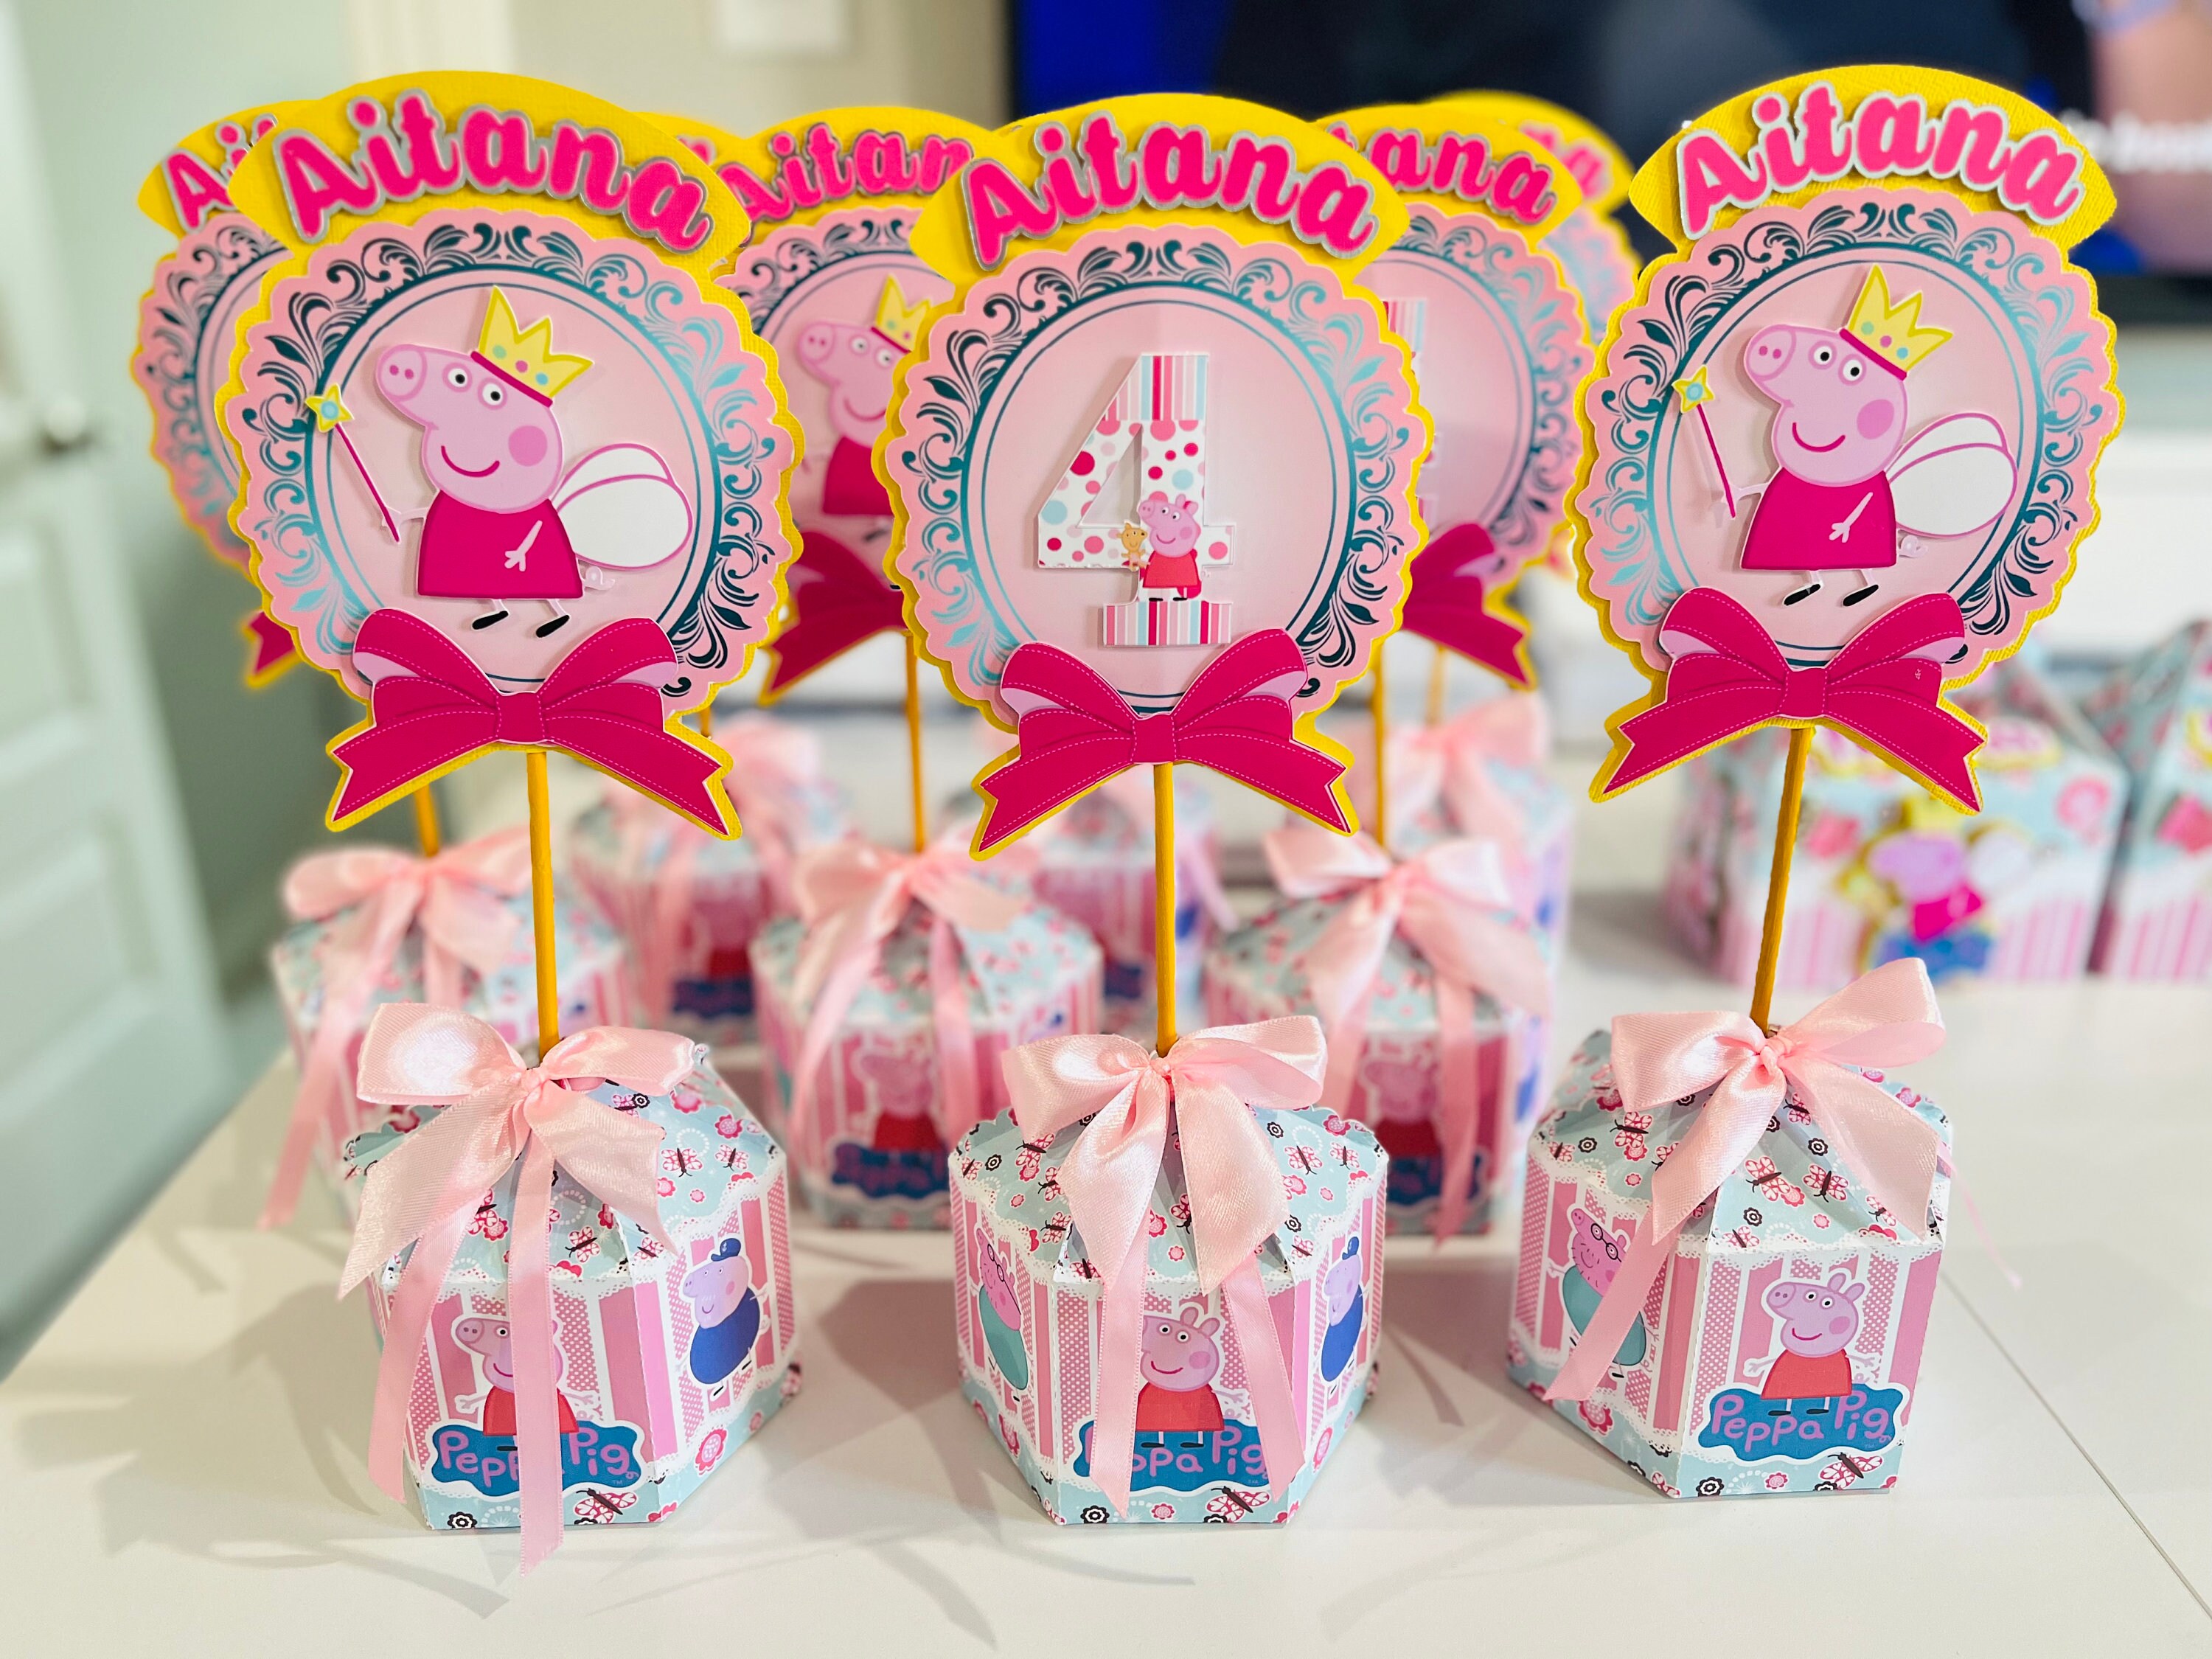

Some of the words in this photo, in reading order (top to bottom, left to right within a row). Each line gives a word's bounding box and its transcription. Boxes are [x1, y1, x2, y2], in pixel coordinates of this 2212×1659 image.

[273, 88, 715, 255] Aitana
[961, 110, 1380, 271] Aitana
[1326, 121, 1557, 226] ana
[1677, 80, 2085, 240] Aitana
[1038, 352, 1236, 647] 4
[568, 1427, 639, 1479] Pig
[1711, 1394, 1823, 1452] Peppa
[1834, 1391, 1892, 1443] Pig
